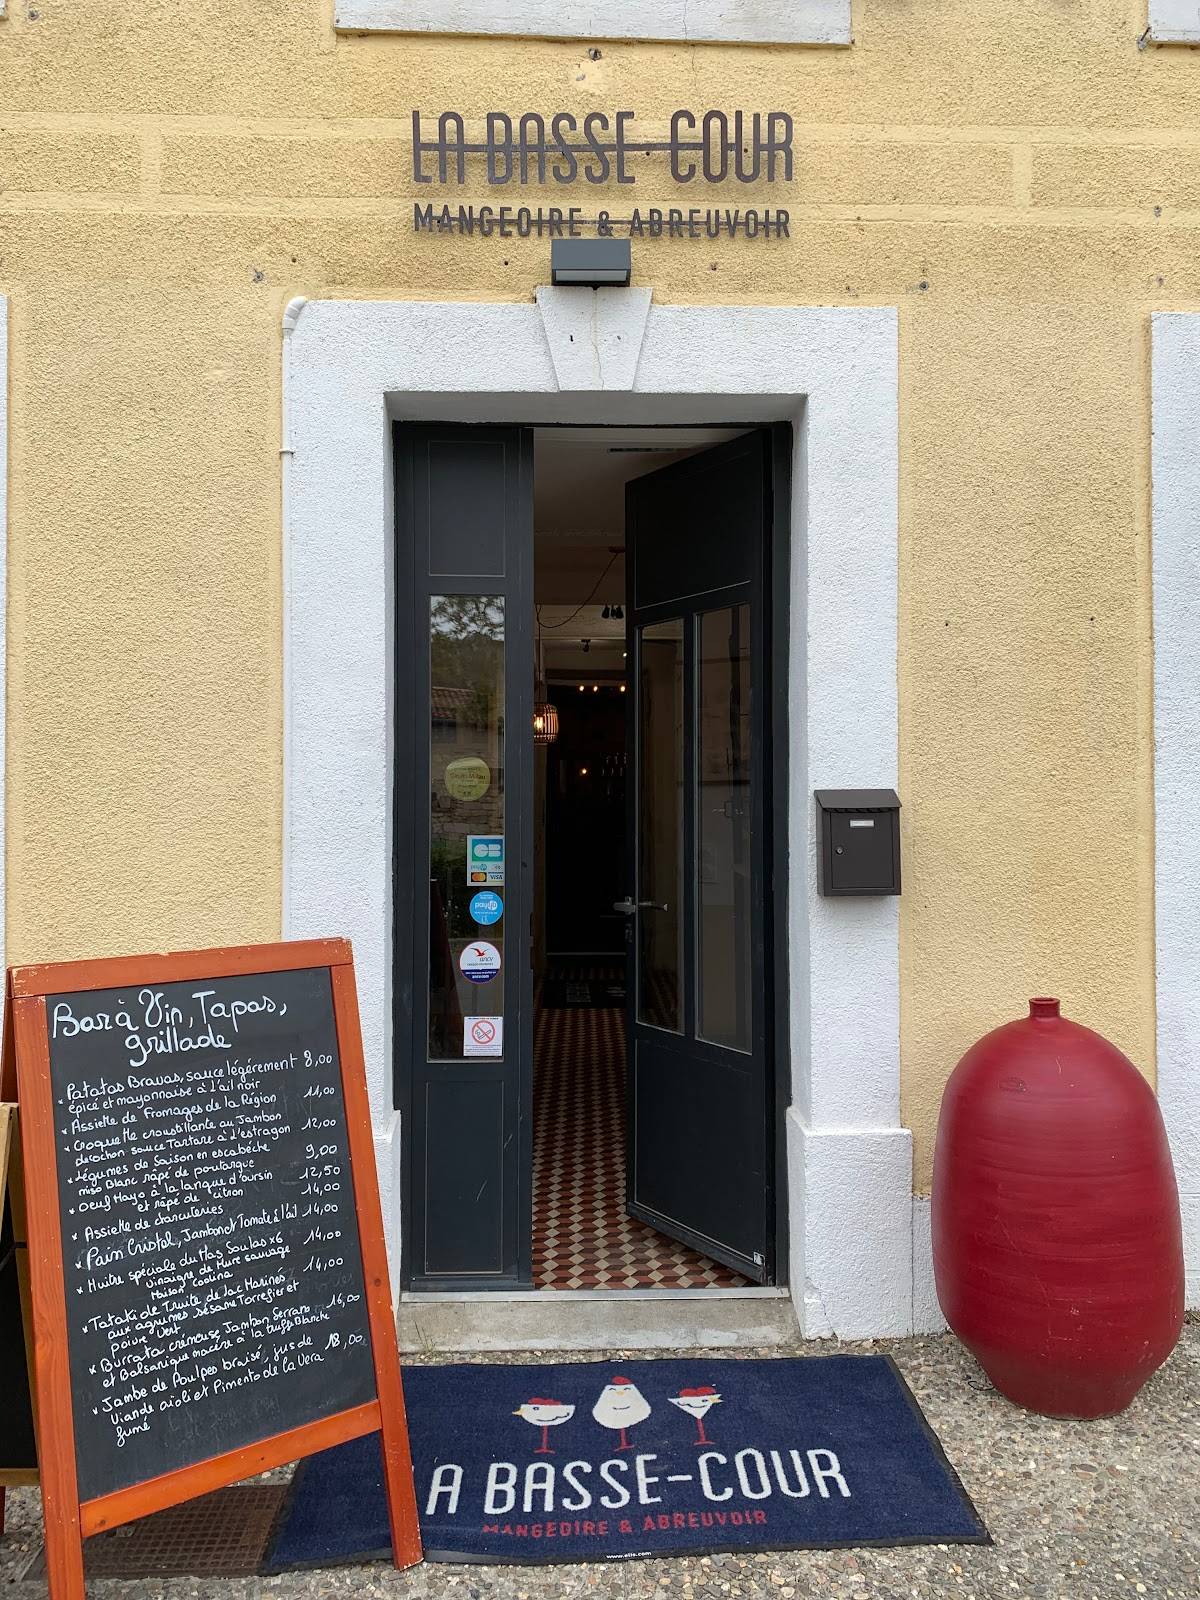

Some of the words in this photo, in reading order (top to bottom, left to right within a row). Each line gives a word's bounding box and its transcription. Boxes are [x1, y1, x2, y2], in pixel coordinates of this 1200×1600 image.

[412, 110, 464, 184] LA
[486, 110, 635, 184] BASSE
[671, 109, 793, 184] COUR
[414, 203, 581, 237] MANGEOIRE
[598, 210, 613, 238] &
[629, 208, 790, 238] ABREUVOIR
[53, 1003, 112, 1038] Bar
[115, 999, 139, 1030] à
[191, 990, 287, 1032] Tapas,
[125, 1024, 231, 1067] grillade
[67, 1078, 124, 1101] Patatas
[128, 1073, 184, 1089] Bravas,
[186, 1069, 224, 1083] sauce
[303, 1050, 332, 1068] 8,00
[69, 1098, 99, 1118] épicé
[103, 1097, 117, 1110] et
[117, 1085, 192, 1109] mayonnaise
[196, 1083, 207, 1093] à
[238, 1079, 260, 1091] noir
[72, 1114, 119, 1135] Assiette
[122, 1111, 138, 1124] de
[206, 1098, 221, 1111] de
[224, 1095, 240, 1108] la
[241, 1092, 277, 1108] Région
[304, 1085, 335, 1098] 11,00
[131, 1145, 167, 1155] sauce
[166, 1135, 214, 1149] Tartare
[217, 1130, 227, 1141] à
[142, 1116, 217, 1140] croustillante
[220, 1120, 234, 1129] au
[236, 1110, 282, 1125] Jambon
[301, 1117, 337, 1130] 12,00
[79, 1185, 103, 1196] miso
[105, 1177, 138, 1190] Blanc
[175, 1166, 189, 1178] de
[194, 1160, 254, 1179] poutargue
[134, 1159, 149, 1170] de
[197, 1151, 208, 1160] en
[306, 1144, 338, 1159] 9,00
[114, 1191, 146, 1206] Mayo
[151, 1184, 160, 1197] à
[165, 1182, 180, 1194] la
[181, 1176, 227, 1195] langue
[229, 1170, 273, 1184] d'oursin
[300, 1165, 341, 1179] 12,50
[137, 1200, 151, 1212] et
[184, 1192, 200, 1203] de
[212, 1188, 244, 1199] citron
[84, 1218, 132, 1242] Assiette
[134, 1217, 151, 1231] de
[155, 1202, 224, 1226] charcuteries
[301, 1182, 341, 1196] 14,00
[87, 1247, 124, 1270] Pain
[237, 1209, 272, 1228] Tomate
[302, 1203, 339, 1217] 14,00
[128, 1259, 177, 1285] spéciale
[180, 1252, 198, 1267] du
[198, 1244, 224, 1262] Mas
[303, 1226, 341, 1244] 14,00
[200, 1264, 214, 1275] de
[217, 1256, 241, 1269] Mure
[244, 1245, 291, 1262] sauvage
[88, 1310, 137, 1330] Tataki
[140, 1305, 160, 1320] de
[162, 1294, 202, 1313] Truite
[206, 1289, 221, 1302] de
[223, 1284, 244, 1297] lac
[303, 1256, 343, 1272] 14,00
[108, 1326, 131, 1340] aux
[135, 1311, 189, 1334] agrumes
[286, 1280, 299, 1292] et
[151, 1287, 185, 1300] Maison
[100, 1345, 166, 1373] Burrata
[222, 1313, 270, 1334] Jambon
[326, 1293, 361, 1308] 16,00
[111, 1336, 148, 1359] poivre
[101, 1384, 149, 1412] Jambe
[151, 1378, 169, 1393] de
[172, 1365, 218, 1388] Poulpes
[272, 1343, 296, 1361] jus
[297, 1334, 314, 1349] de
[324, 1333, 364, 1350] 18,00
[102, 1372, 117, 1388] et
[237, 1330, 246, 1344] à
[251, 1328, 266, 1339] la
[193, 1384, 209, 1401] et
[213, 1369, 262, 1394] Pimento
[263, 1363, 279, 1379] de
[281, 1356, 297, 1373] la
[297, 1353, 325, 1367] Vera
[115, 1416, 151, 1447] fumé
[425, 1463, 464, 1515] A
[484, 1448, 852, 1515] BASSE-COUR
[483, 1520, 607, 1538] MANGEOIRE
[620, 1519, 633, 1533] &
[644, 1509, 768, 1531] ABREUVOIR
